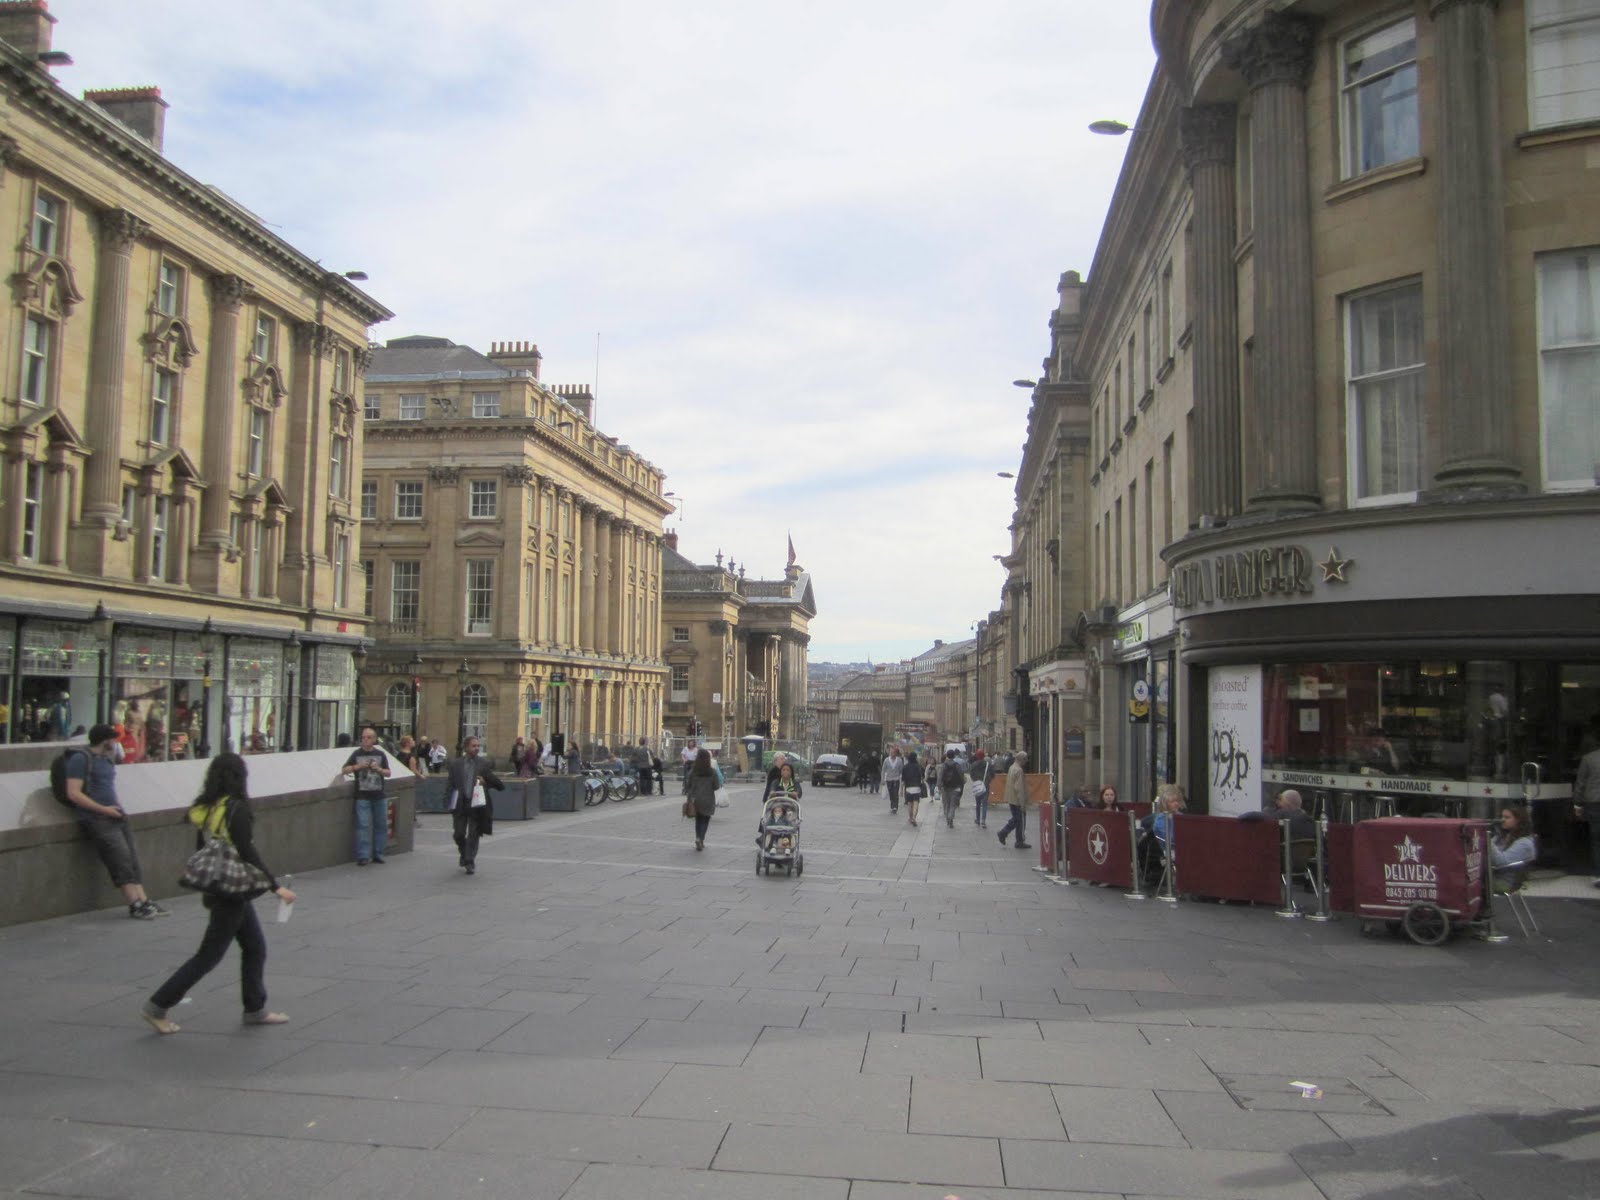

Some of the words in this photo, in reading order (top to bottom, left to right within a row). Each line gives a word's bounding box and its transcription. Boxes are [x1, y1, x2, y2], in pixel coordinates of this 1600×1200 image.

[1216, 545, 1314, 601] MANGER
[1282, 772, 1324, 785] SANDWICHES
[1380, 780, 1432, 793] HANDMADE
[1384, 864, 1437, 882] DELIVERS
